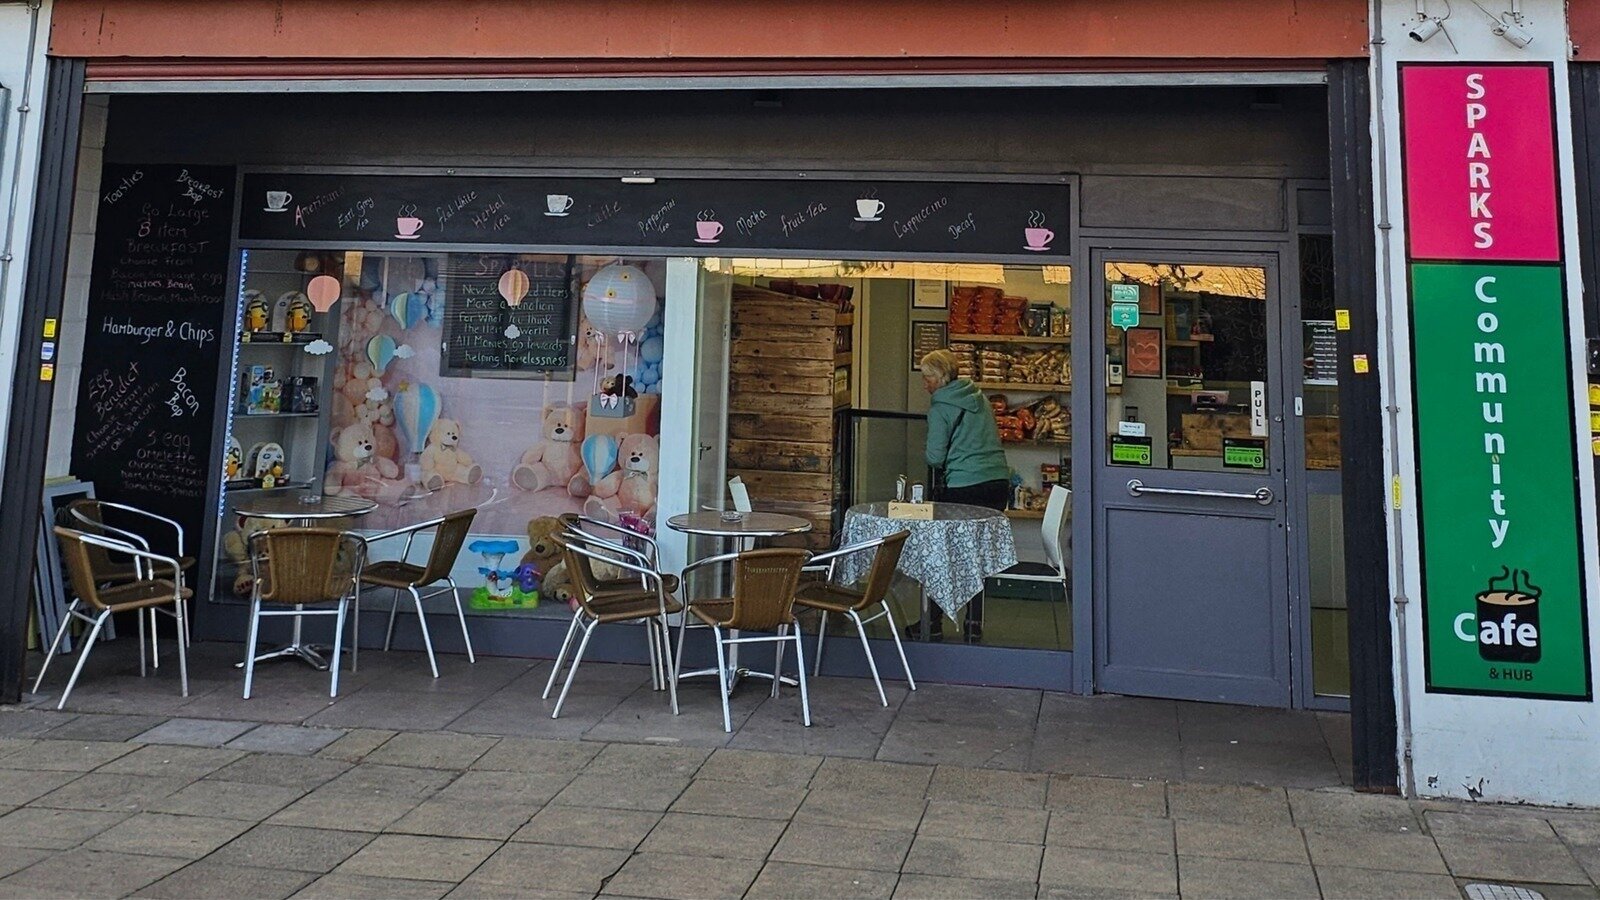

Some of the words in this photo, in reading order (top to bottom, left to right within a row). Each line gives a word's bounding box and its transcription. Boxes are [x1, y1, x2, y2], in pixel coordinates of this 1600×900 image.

[1465, 73, 1494, 249] SPARKS
[103, 169, 144, 205] Toasties
[736, 209, 768, 236] Mocha
[948, 212, 976, 240] Decaf
[102, 316, 163, 345] Hamburger
[165, 320, 176, 338] &
[179, 321, 215, 349] Chips
[164, 391, 183, 418] Bap
[169, 366, 199, 417] Bacon
[1254, 390, 1262, 426] PULL
[1474, 275, 1509, 549] Community
[1453, 611, 1538, 647] Cafe
[1488, 667, 1500, 679] &
[1503, 668, 1533, 681] HUB
